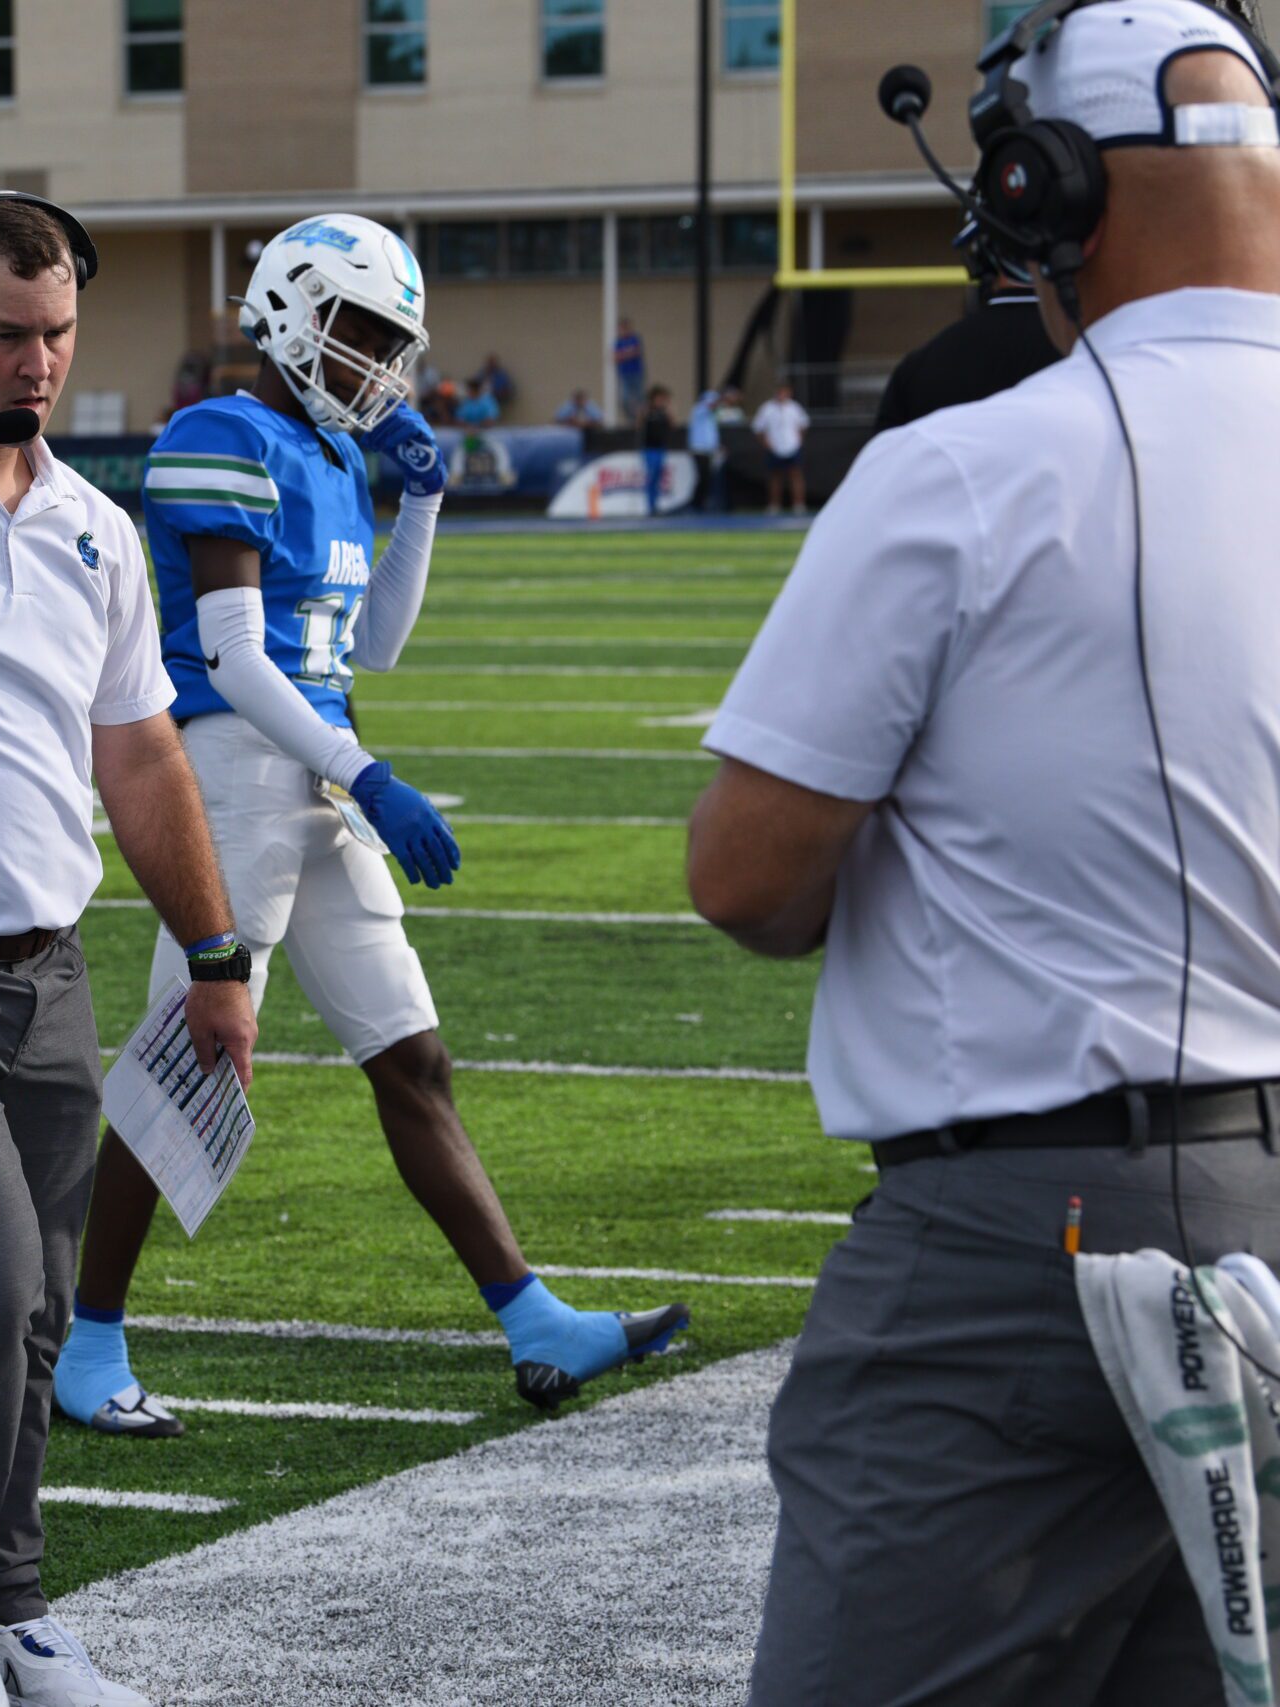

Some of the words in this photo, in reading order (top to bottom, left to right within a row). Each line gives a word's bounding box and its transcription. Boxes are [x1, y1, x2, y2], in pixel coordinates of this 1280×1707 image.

[282, 219, 359, 252] Argos
[1172, 1270, 1208, 1391] POWER
[1205, 1457, 1254, 1636] POWERADE
